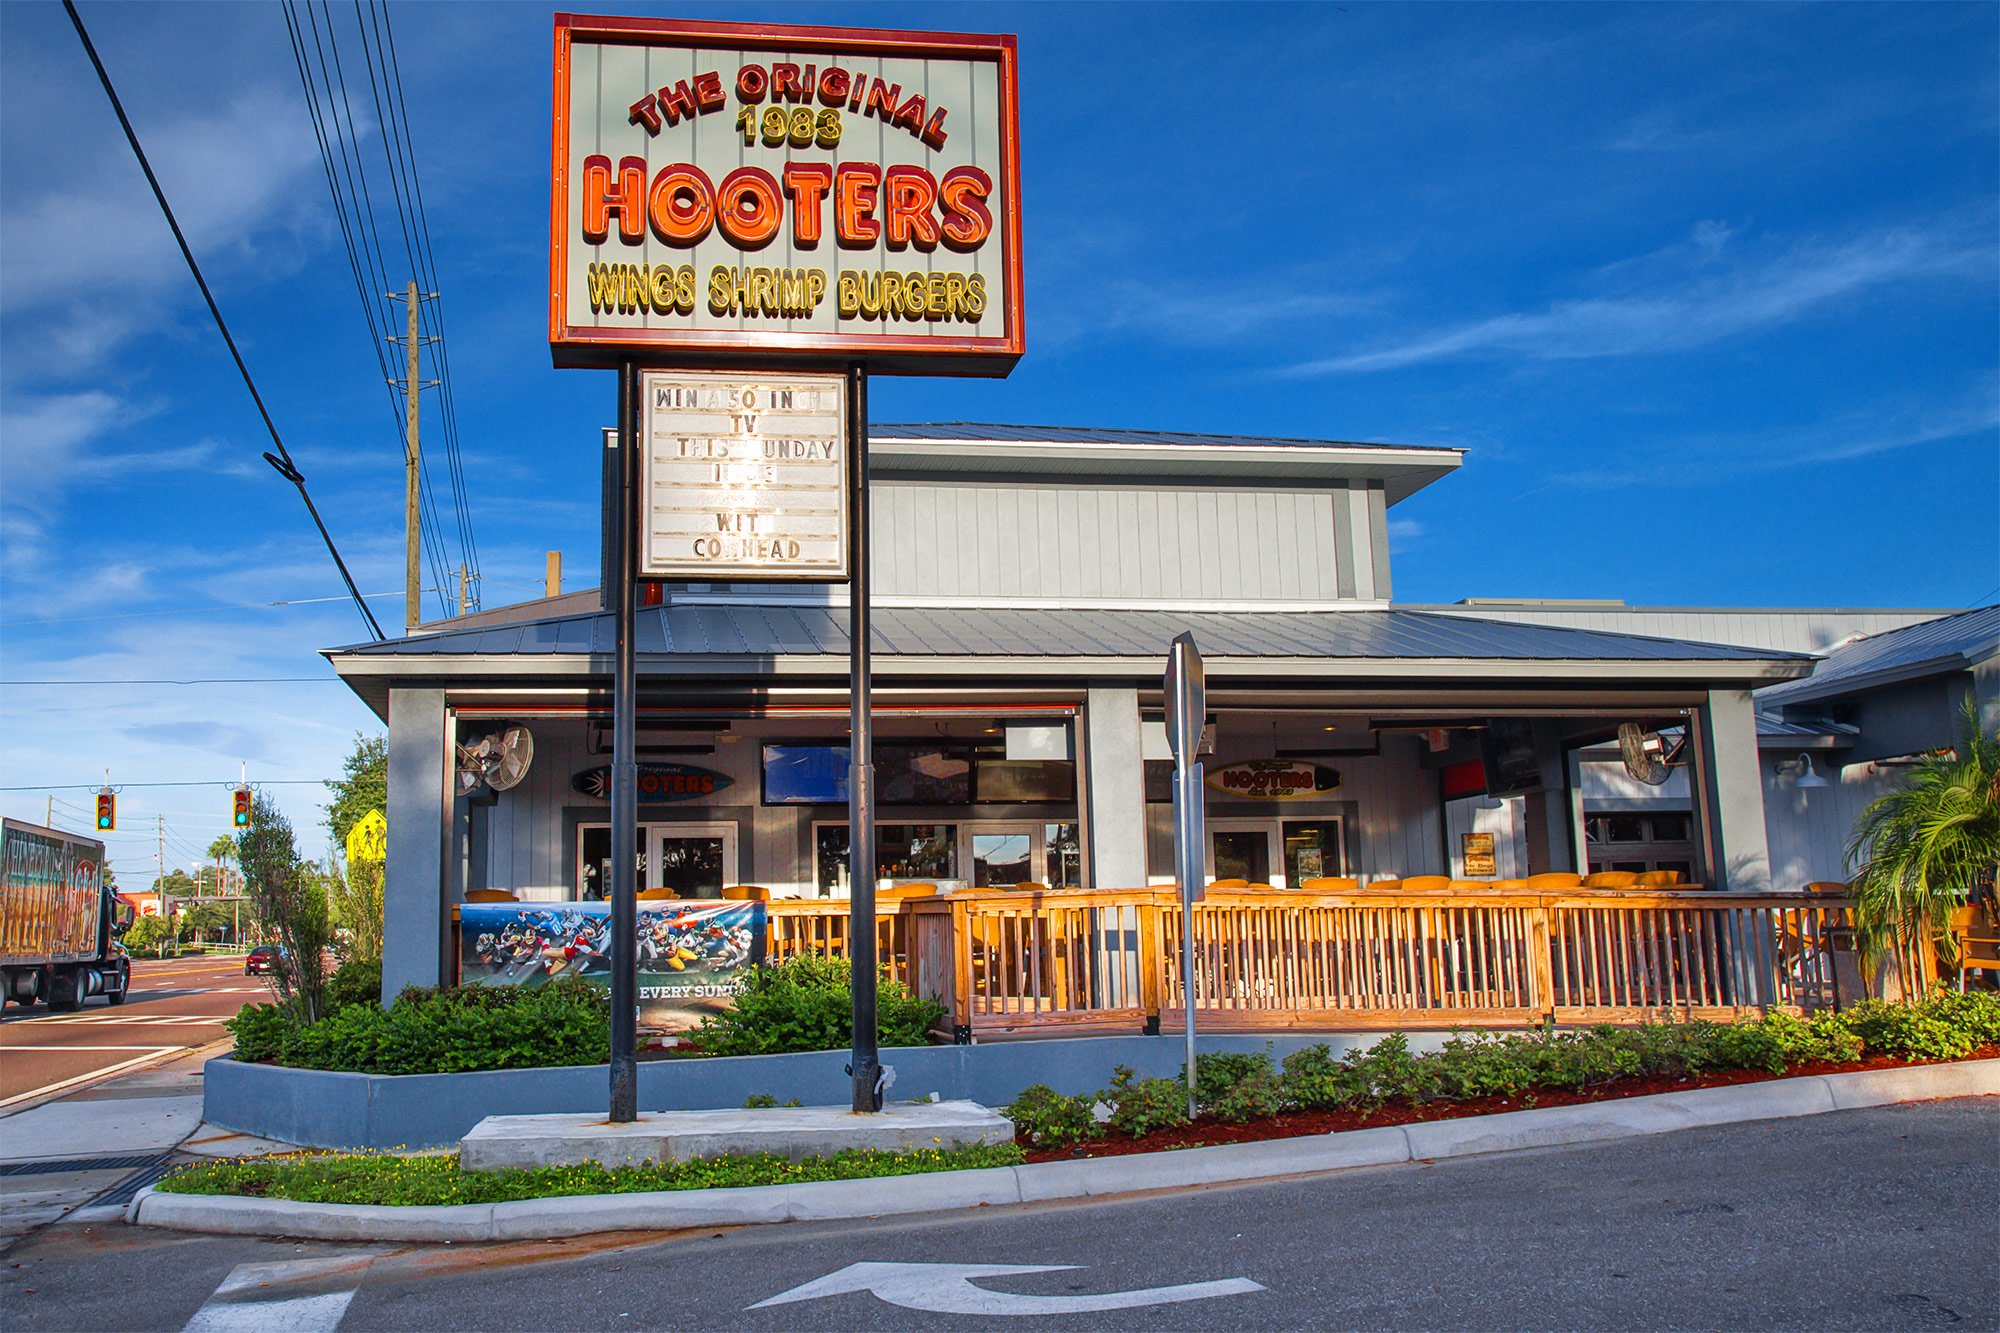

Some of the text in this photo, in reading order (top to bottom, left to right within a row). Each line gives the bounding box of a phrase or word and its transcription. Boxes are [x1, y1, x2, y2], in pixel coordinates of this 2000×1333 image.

[629, 62, 949, 152] THE ORIGINAL
[737, 104, 843, 149] 1983
[583, 155, 993, 250] HOOTERS
[588, 262, 987, 322] WINGS SHRIMP BURGERS
[656, 388, 698, 407] WIN
[730, 414, 756, 433] TV
[677, 438, 729, 457] THIS
[1223, 770, 1314, 789] HOOTERS
[639, 986, 691, 999] EVERY
